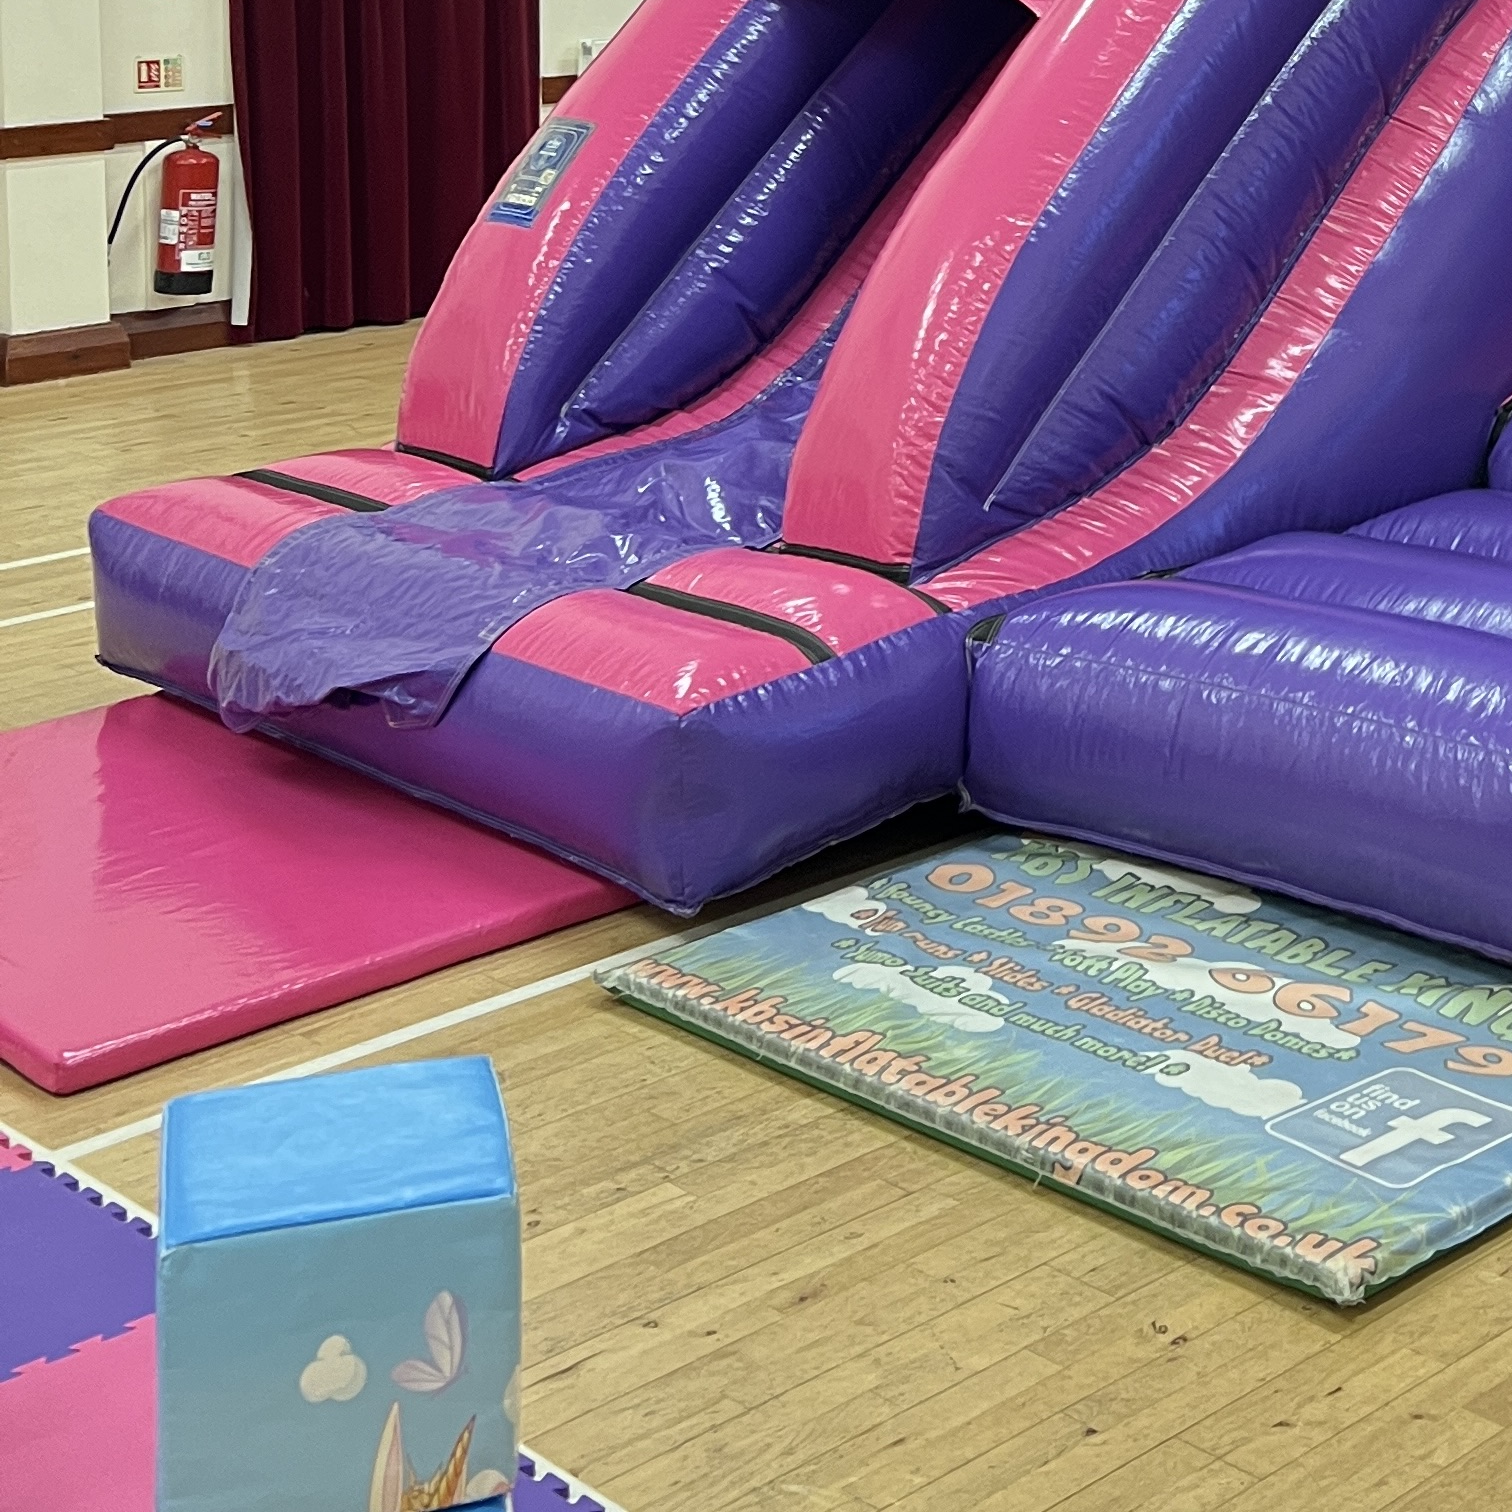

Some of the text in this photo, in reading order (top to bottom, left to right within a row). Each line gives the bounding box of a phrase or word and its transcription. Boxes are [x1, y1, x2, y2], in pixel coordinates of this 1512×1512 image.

[926, 862, 1194, 962] 01892
[1088, 870, 1400, 986] INFLATABLE
[958, 991, 1028, 1020] and
[1002, 1009, 1087, 1042] much
[1070, 1035, 1172, 1072] more!
[974, 955, 1055, 993] Slides
[1064, 991, 1194, 1043] Gladiator
[1099, 960, 1168, 1002] Play
[1176, 994, 1252, 1029] Disco
[1329, 1100, 1367, 1120] on
[1346, 1092, 1382, 1111] us
[1361, 1083, 1421, 1110] find
